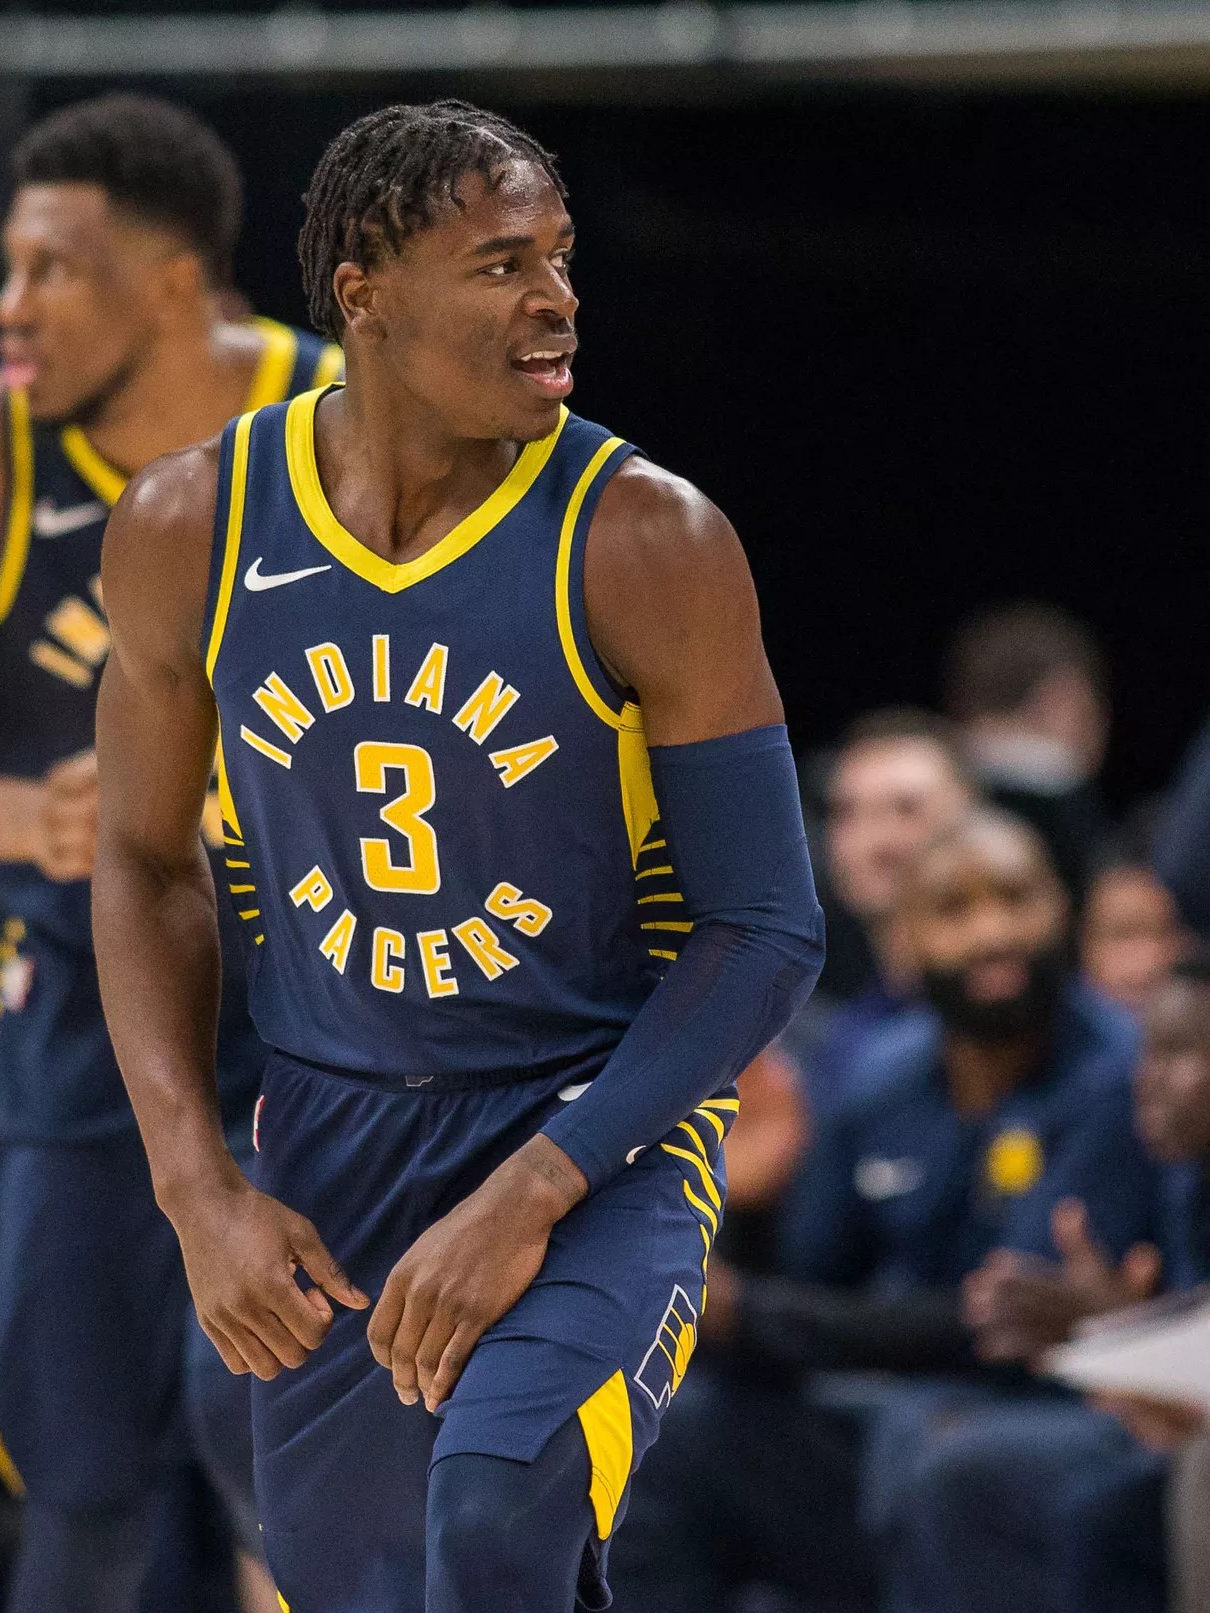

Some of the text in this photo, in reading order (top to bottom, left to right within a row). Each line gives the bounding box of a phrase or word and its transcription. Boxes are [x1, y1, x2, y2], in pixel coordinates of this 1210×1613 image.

[240, 633, 559, 788] INDIANA
[353, 740, 441, 895] 3
[289, 864, 553, 998] PACERS
